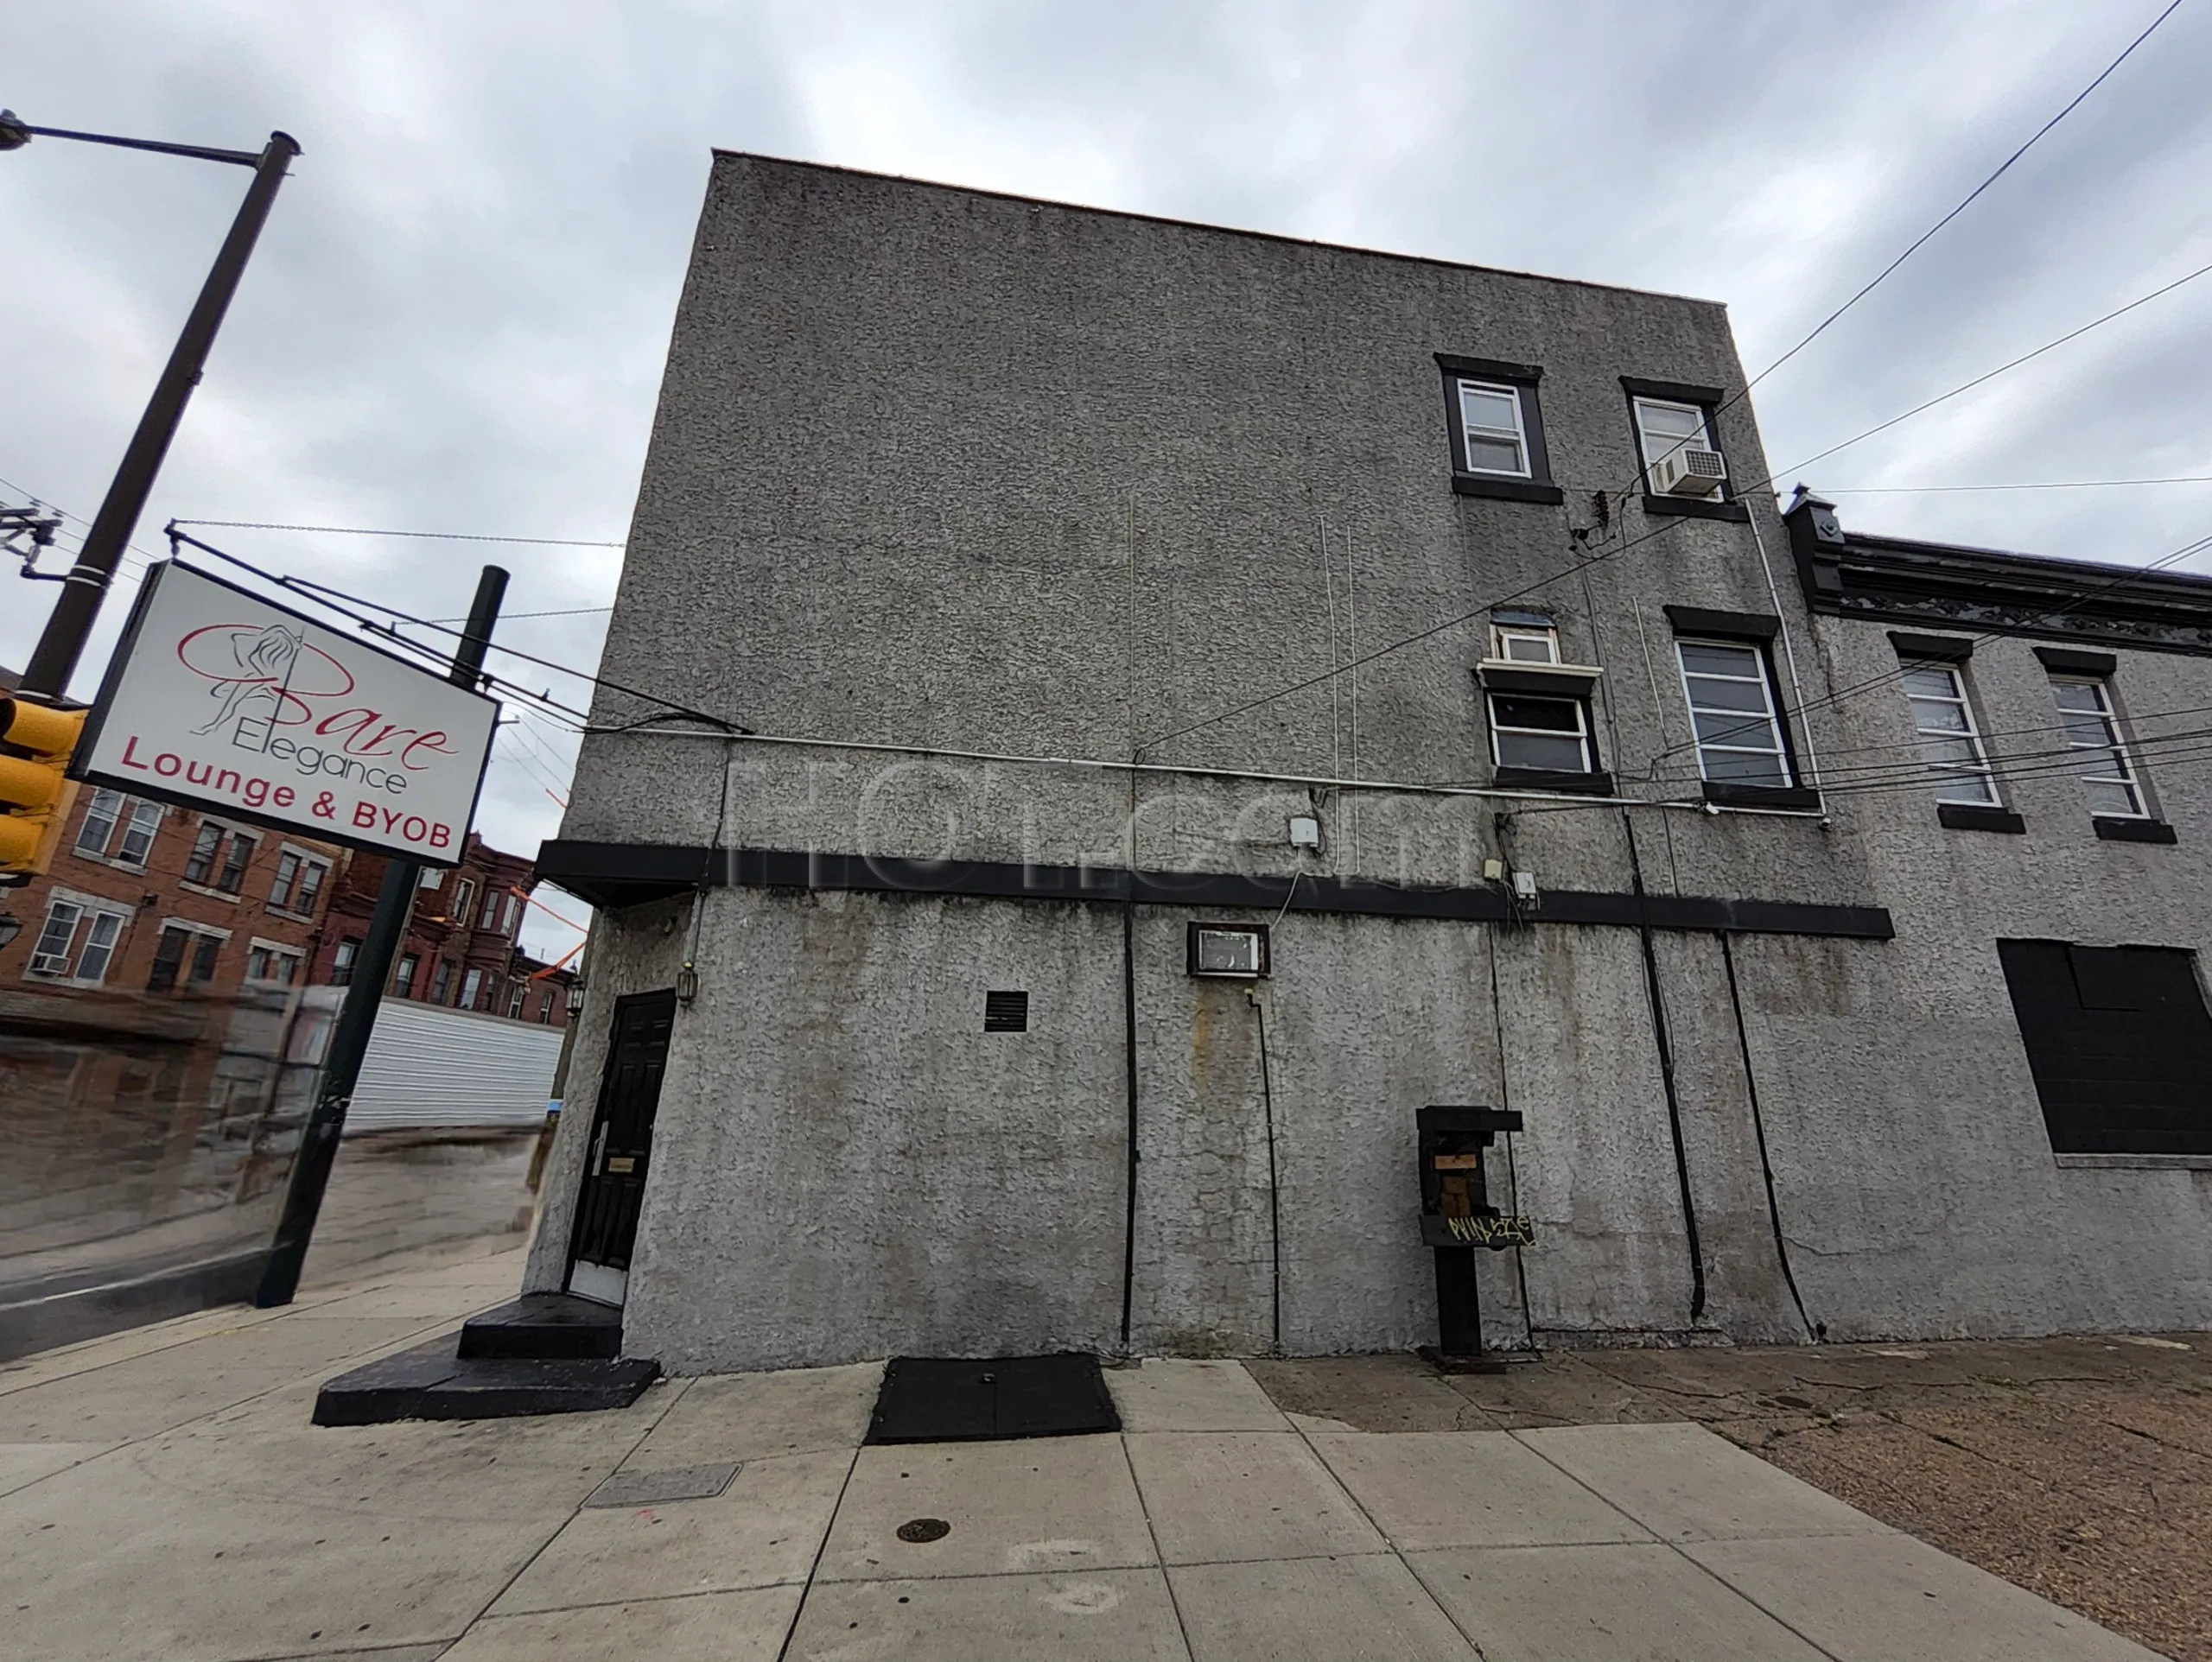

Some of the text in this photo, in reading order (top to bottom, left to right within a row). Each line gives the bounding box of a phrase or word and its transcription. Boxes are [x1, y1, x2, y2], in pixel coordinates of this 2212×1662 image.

[177, 625, 460, 771] Bare
[121, 735, 451, 848] Lounge & BYOB
[232, 716, 408, 795] Elegance
